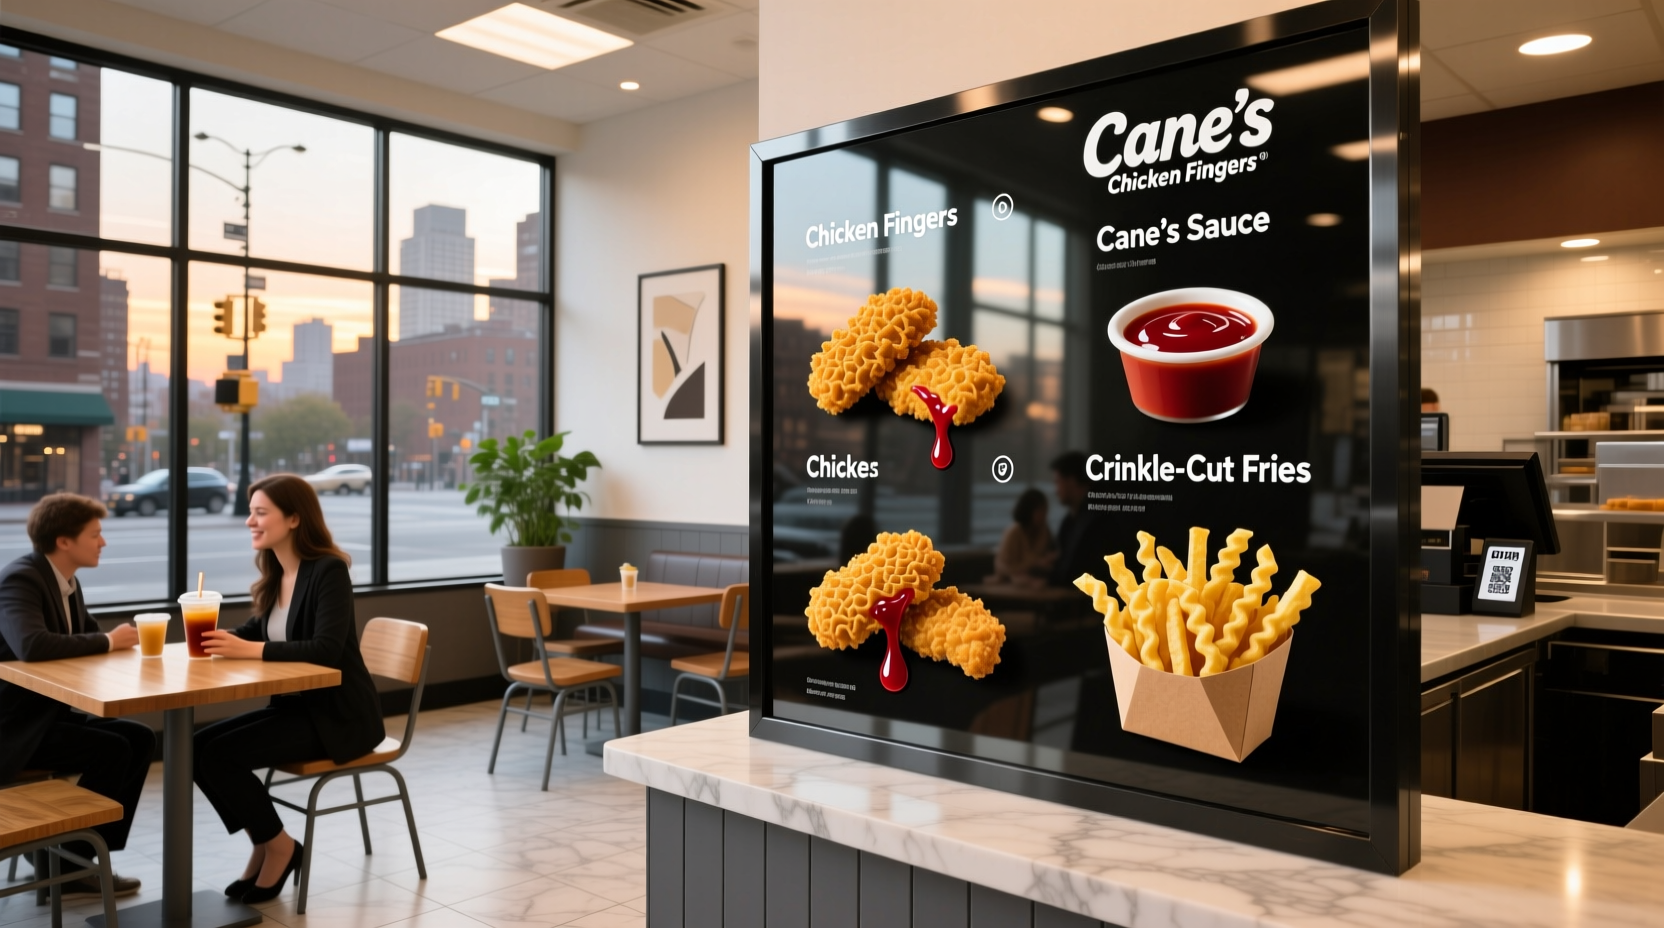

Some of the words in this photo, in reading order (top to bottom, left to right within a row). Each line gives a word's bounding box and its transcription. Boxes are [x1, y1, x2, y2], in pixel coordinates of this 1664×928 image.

[1083, 88, 1275, 178] Cane's
[1107, 168, 1181, 195] Chicken
[1185, 155, 1258, 183] Fingers
[805, 219, 878, 249] Chicken
[884, 205, 958, 238] Fingers
[1096, 217, 1180, 252] Cane's
[1186, 211, 1271, 241] Sauce
[806, 453, 879, 479] Chickes
[1085, 453, 1235, 483] Crinkle-Cut
[1242, 453, 1312, 484] Fries
